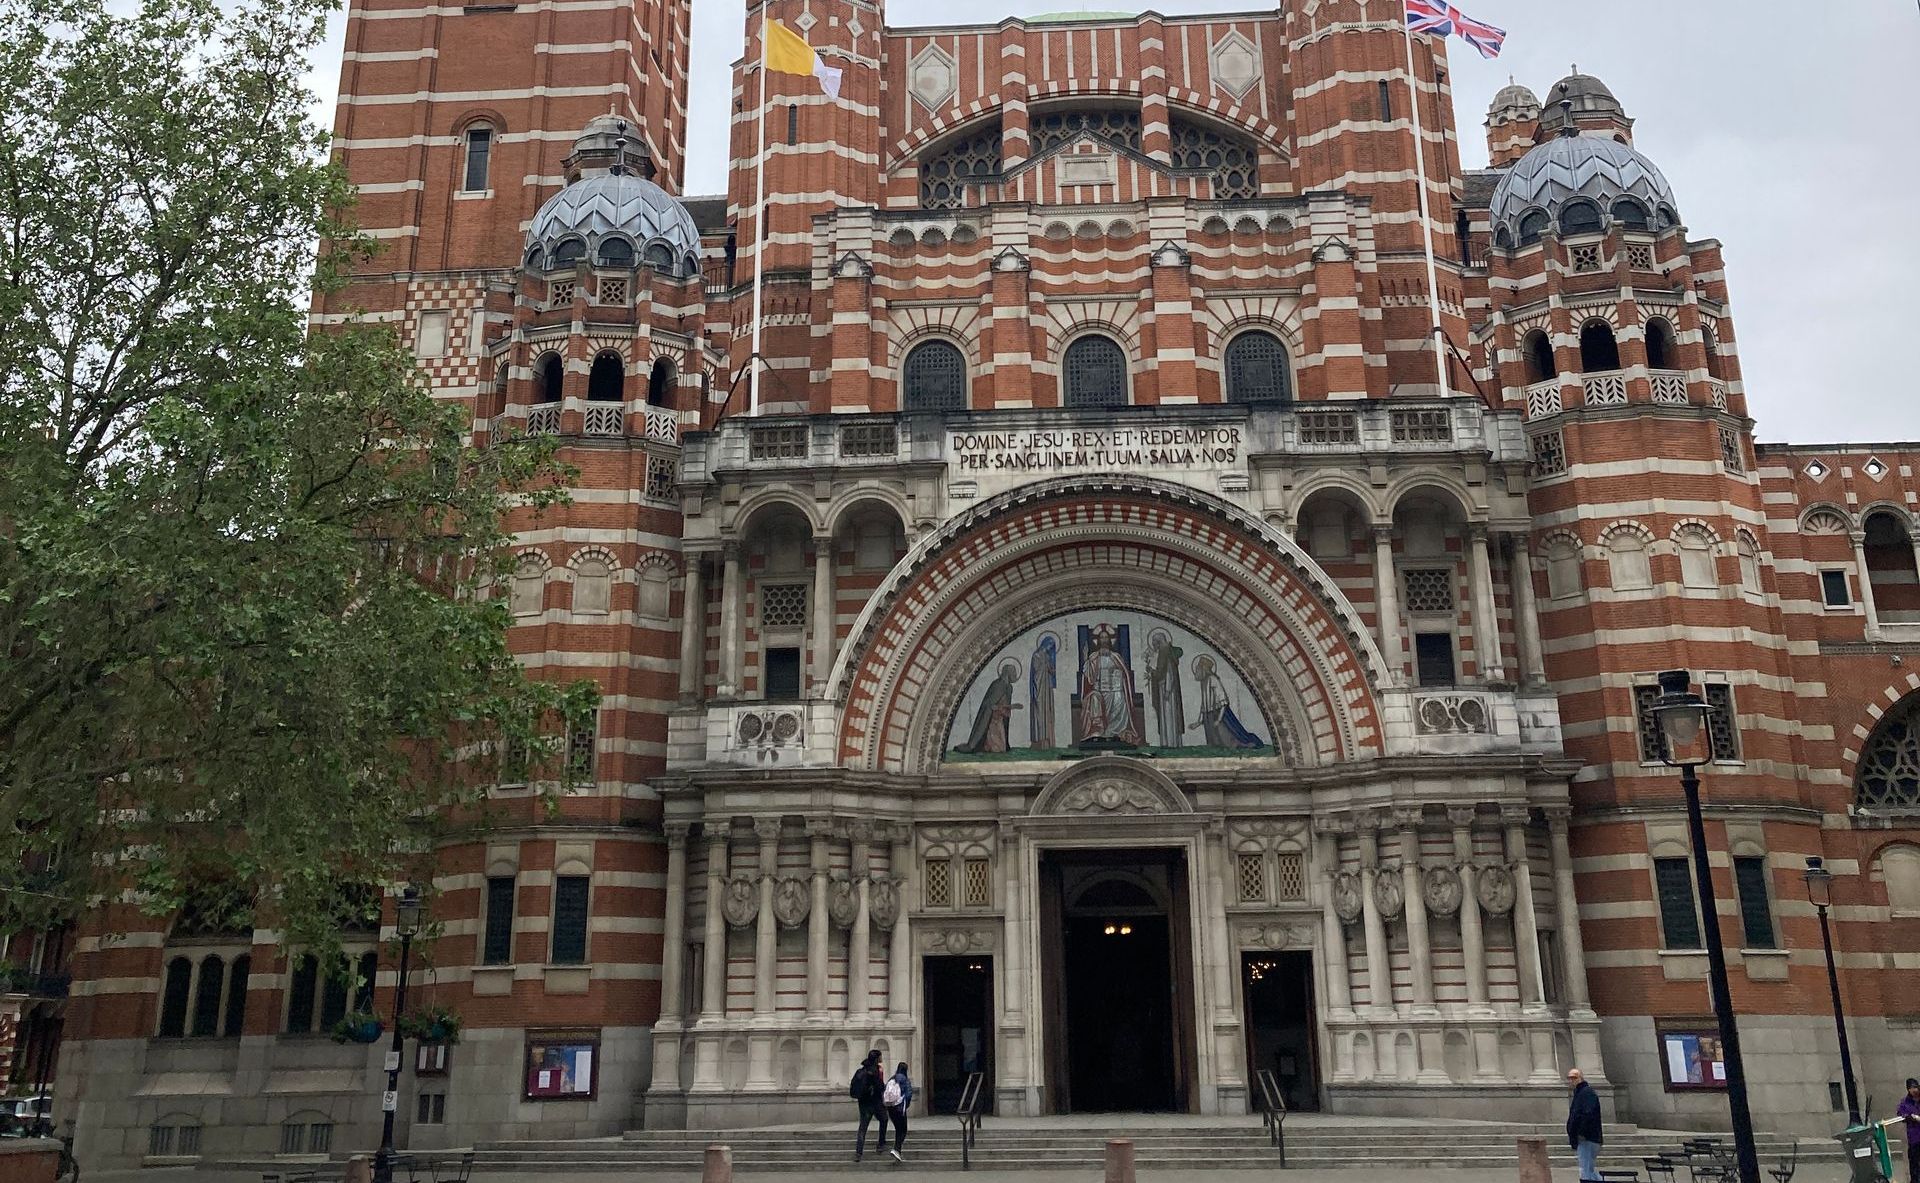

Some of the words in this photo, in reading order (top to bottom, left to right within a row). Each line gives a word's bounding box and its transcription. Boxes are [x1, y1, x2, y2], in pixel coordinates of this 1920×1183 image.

[953, 433, 1017, 450] DOMINE
[1024, 432, 1064, 448] JESU
[1072, 431, 1106, 447] REX
[1113, 430, 1133, 446] ET
[1140, 428, 1241, 446] REDEMPTOR
[960, 453, 989, 469] PER
[994, 451, 1088, 469] SANGUINEM
[1095, 450, 1142, 465] TUUM
[1150, 448, 1195, 465] SALVA
[1202, 447, 1236, 463] NOS
